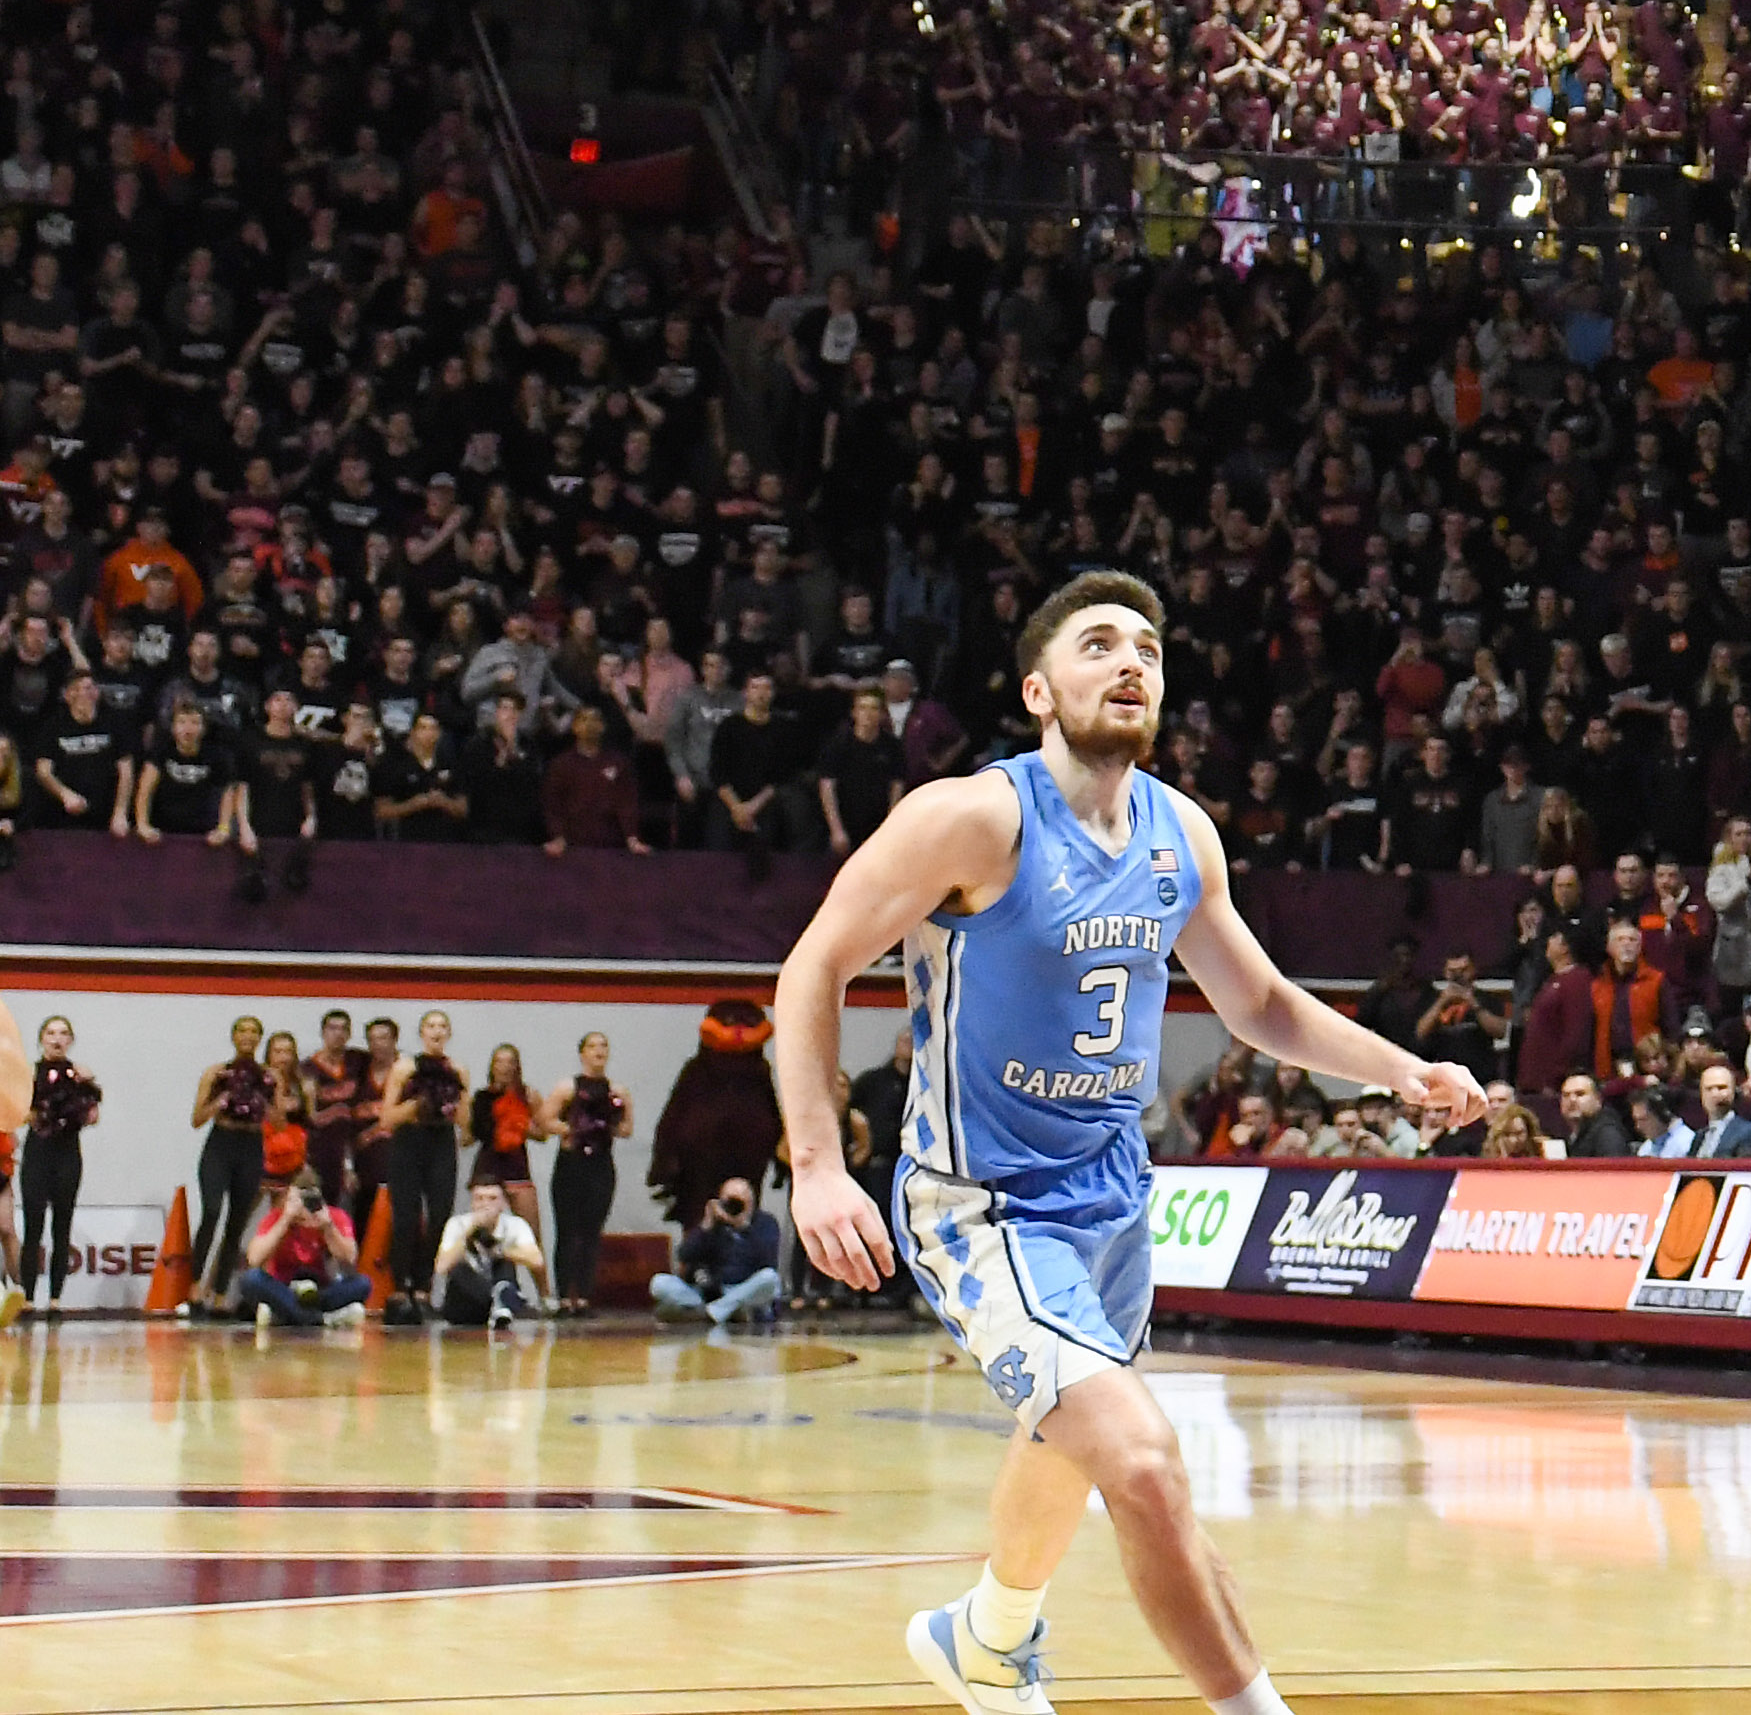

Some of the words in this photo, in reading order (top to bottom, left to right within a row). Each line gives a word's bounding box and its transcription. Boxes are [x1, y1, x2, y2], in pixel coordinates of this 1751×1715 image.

[1062, 914, 1162, 956] NORTH
[1073, 963, 1131, 1057] 3
[1002, 1058, 1148, 1100] CAROLINA
[1435, 1209, 1546, 1255] MARTIN
[1547, 1212, 1649, 1258] TRAVEL
